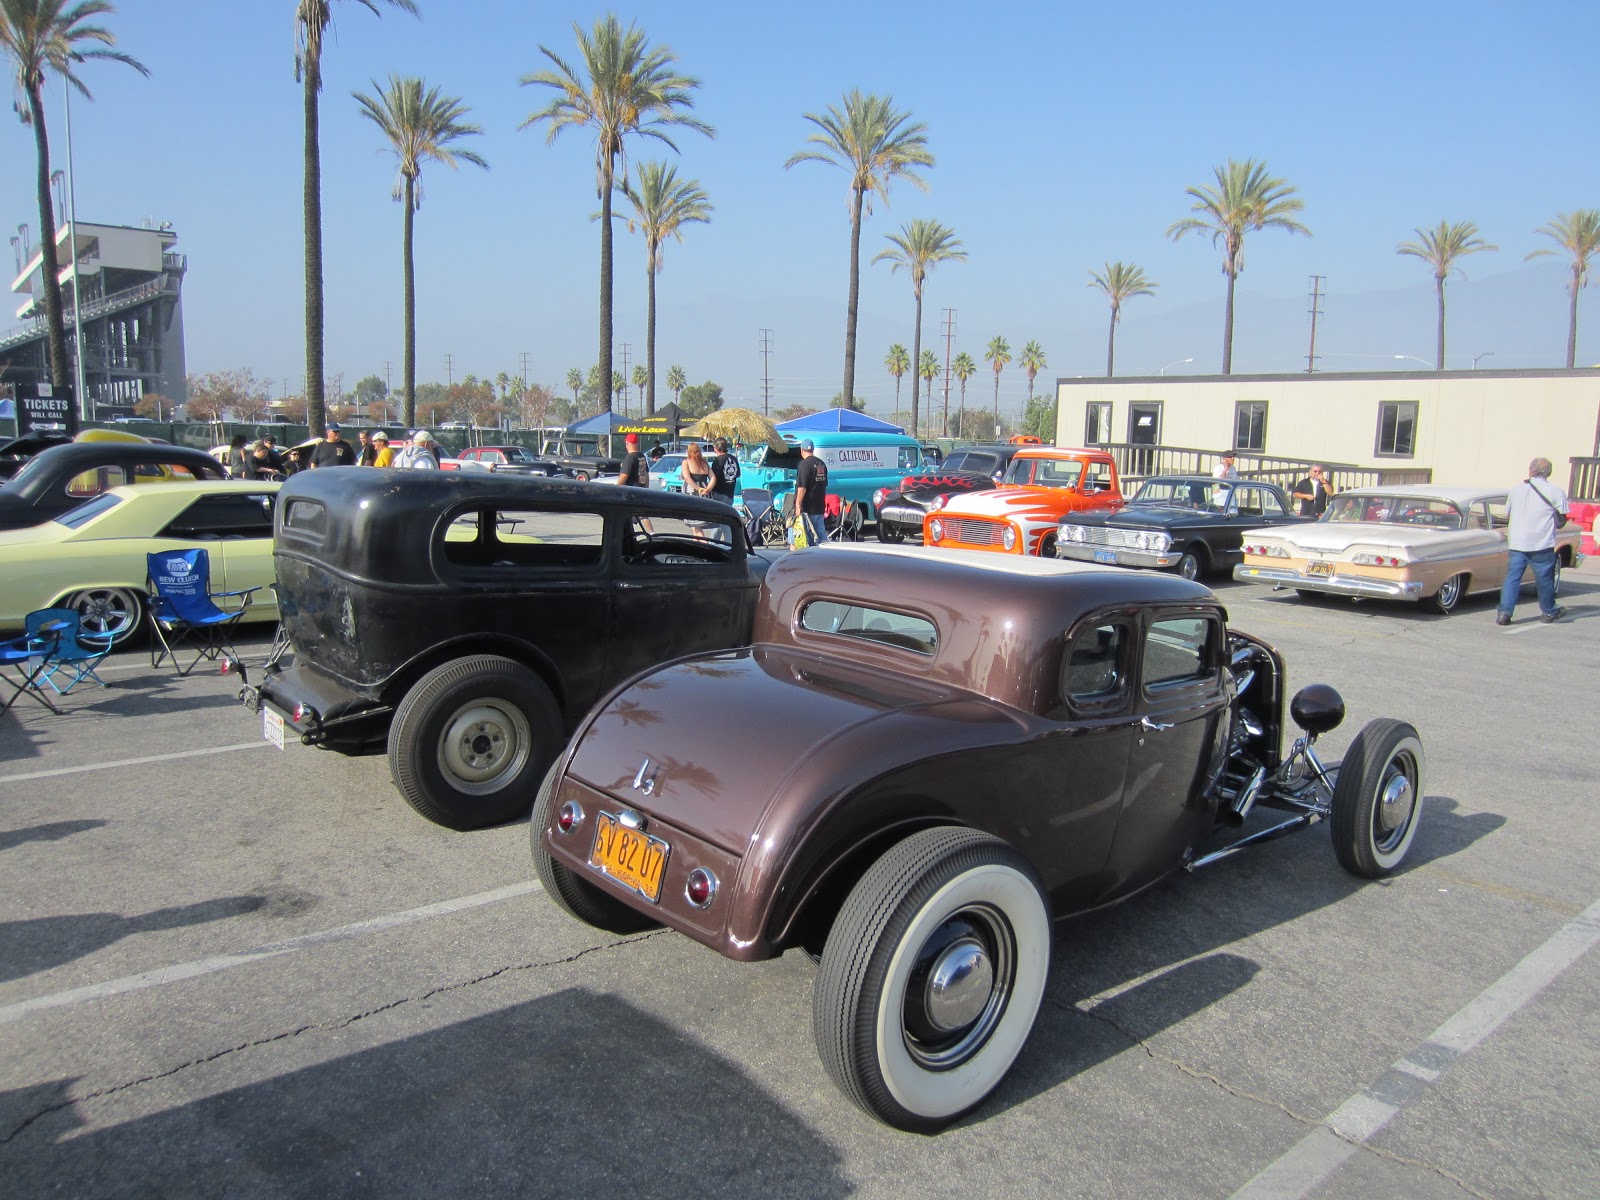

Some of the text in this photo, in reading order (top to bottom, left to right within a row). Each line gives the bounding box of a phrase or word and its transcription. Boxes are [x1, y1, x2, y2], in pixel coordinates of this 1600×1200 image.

[24, 399, 69, 411] TICKETS
[31, 411, 63, 419] WILL CALL
[838, 449, 879, 462] CALIFORNIA
[159, 574, 200, 583] NEW CLUTCH
[618, 832, 640, 872] 82
[640, 842, 664, 882] 07
